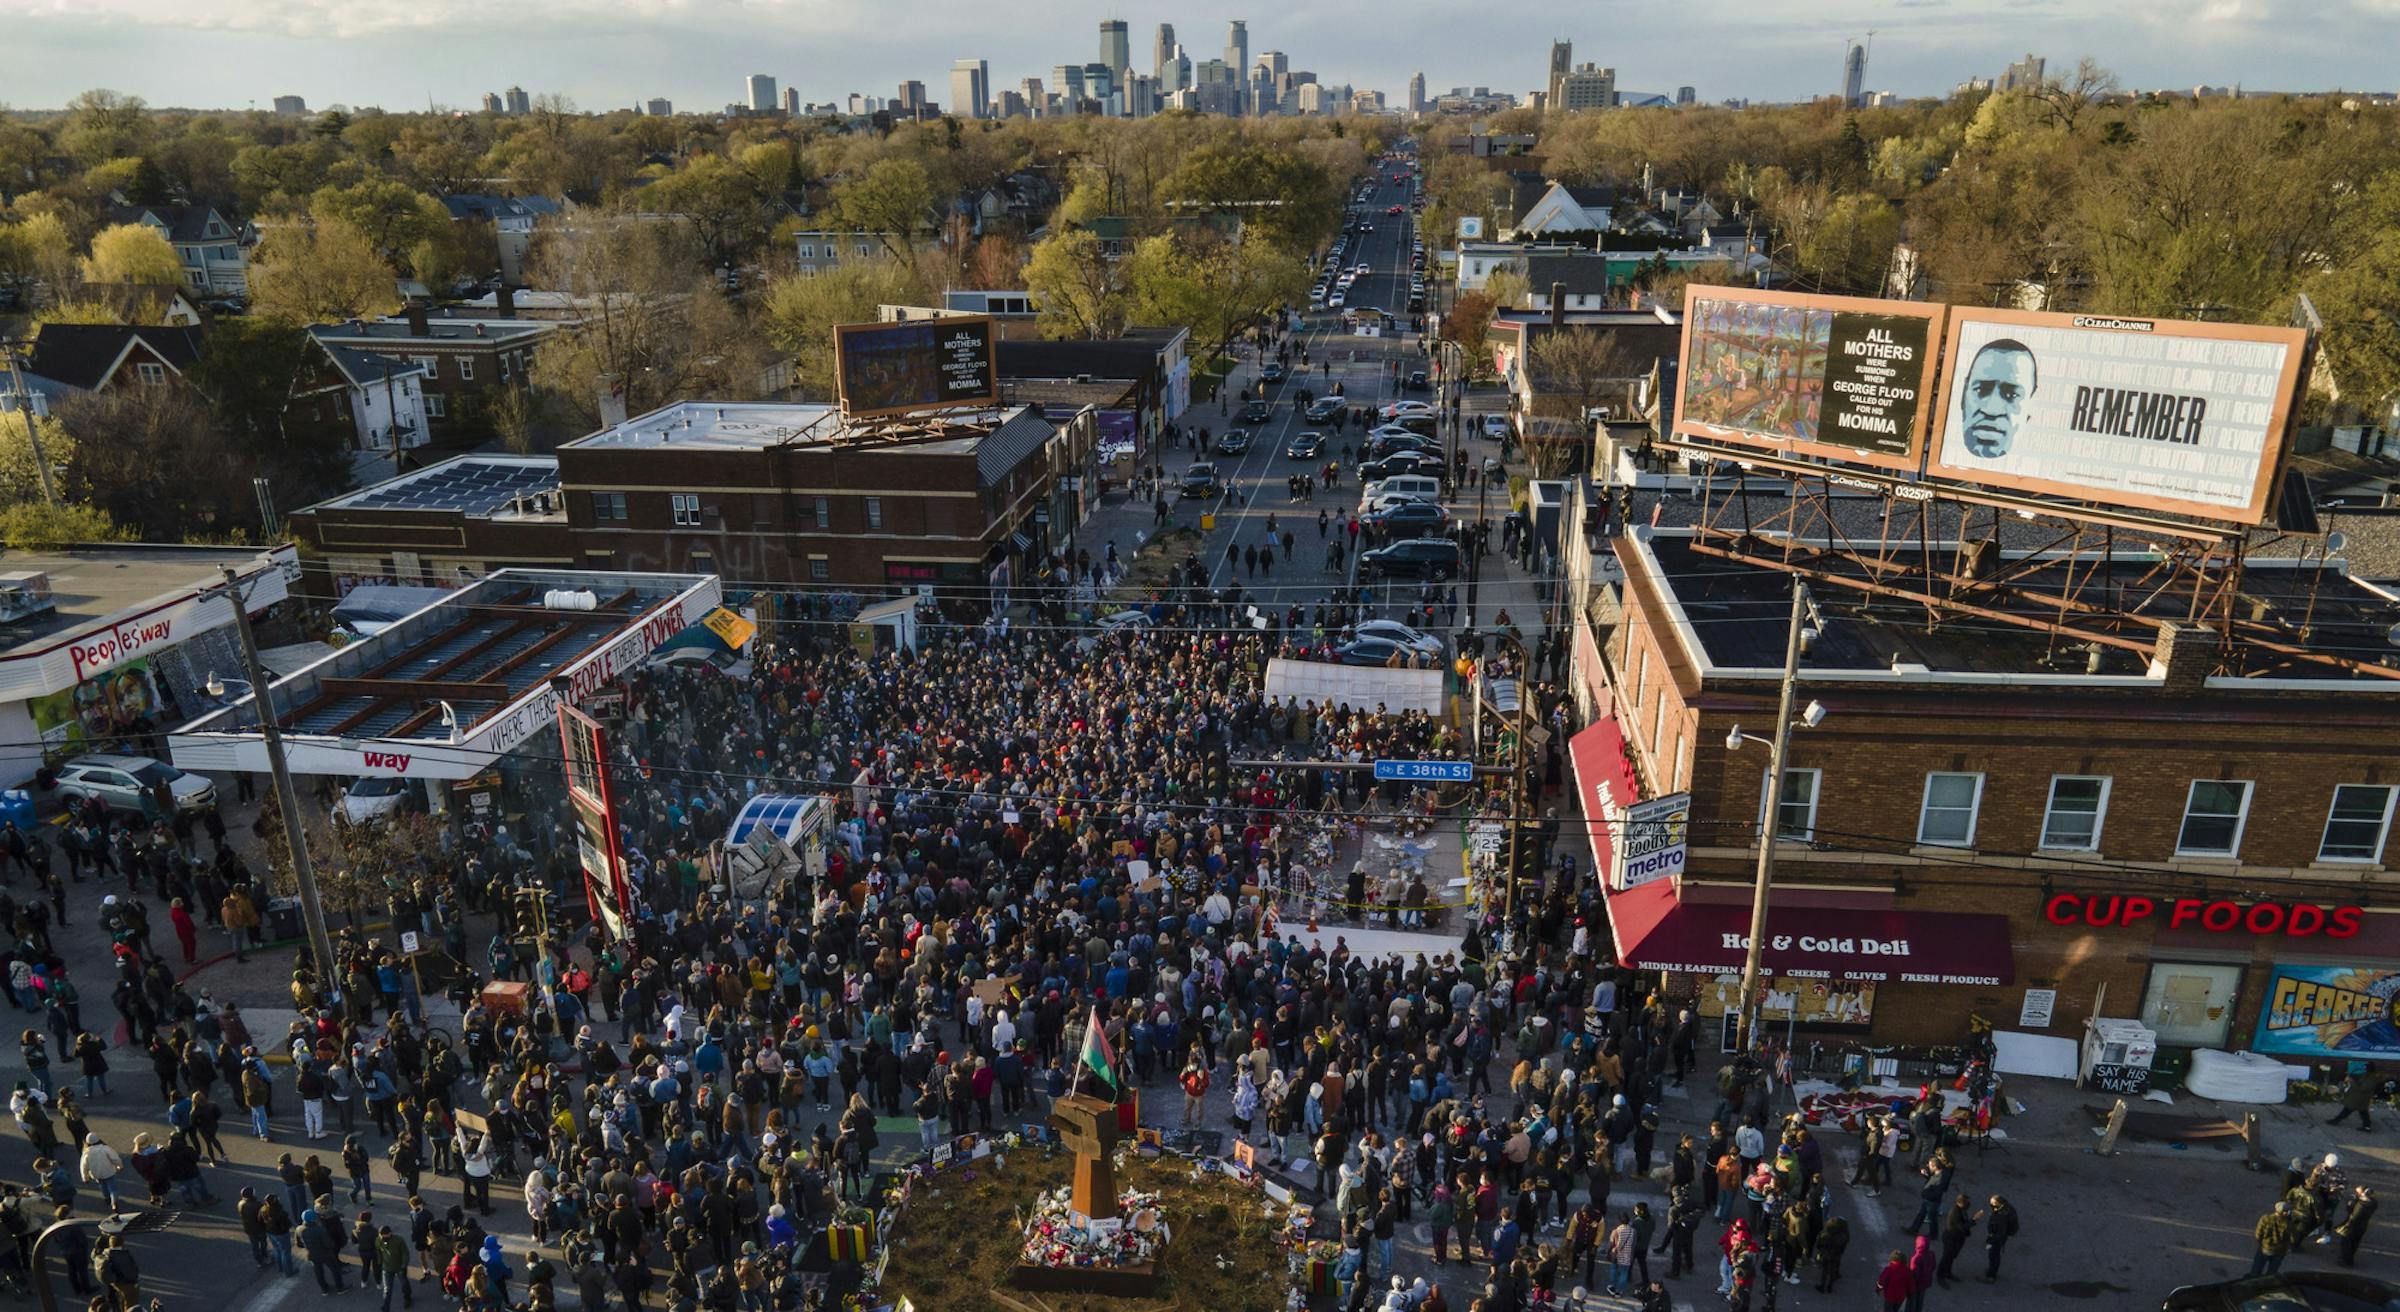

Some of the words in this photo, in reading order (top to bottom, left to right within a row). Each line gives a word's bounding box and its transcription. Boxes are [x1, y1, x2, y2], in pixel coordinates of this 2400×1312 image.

[944, 338, 982, 349] MOTHERS
[955, 332, 970, 340] ALL
[1866, 328, 1893, 343] ALL
[1844, 341, 1912, 360] MOTHERS
[1866, 358, 1887, 367] WERE
[1855, 365, 1896, 377] SUMMONED
[1864, 374, 1886, 384] WHEN
[948, 379, 982, 390] MOMMA
[1833, 381, 1877, 396] GEORGE
[1879, 386, 1914, 400] FLOYD
[1850, 395, 1877, 405] CALLED
[1878, 398, 1893, 407] OUT
[1856, 405, 1871, 414] FOR
[1872, 407, 1883, 415] HIS
[2070, 385, 2207, 445] REMEMBER
[1838, 413, 1897, 434] MOMMA
[1839, 477, 1854, 486] Clear
[489, 711, 526, 752] WHERE
[567, 651, 615, 706] PEOPLE
[642, 601, 687, 657] POWER
[364, 751, 411, 773] way
[1396, 765, 1406, 775] E
[1412, 765, 1446, 777] 38th
[1452, 766, 1469, 777] St
[1481, 838, 1501, 849] 25
[1627, 834, 1667, 857] Foods
[1627, 850, 1684, 878] metro
[2046, 893, 2155, 928] CUP
[2170, 898, 2366, 939] FOODS
[1722, 933, 1765, 949] Ho
[1772, 935, 1793, 951] &
[1799, 936, 1855, 953] Cold
[1860, 939, 1911, 956] Deli
[1638, 961, 1683, 972] MIDDLE
[1684, 964, 1738, 975] EASTERN
[1786, 969, 1831, 979] CHEESE
[1844, 971, 1888, 981] OLIVES
[1900, 973, 1940, 983] FRESH
[1941, 976, 2000, 986] PRODUCE
[2267, 976, 2385, 1031] GEORGE
[2097, 1065, 2120, 1077] SAY
[2126, 1068, 2148, 1081] HIS
[2101, 1078, 2139, 1094] NAME
